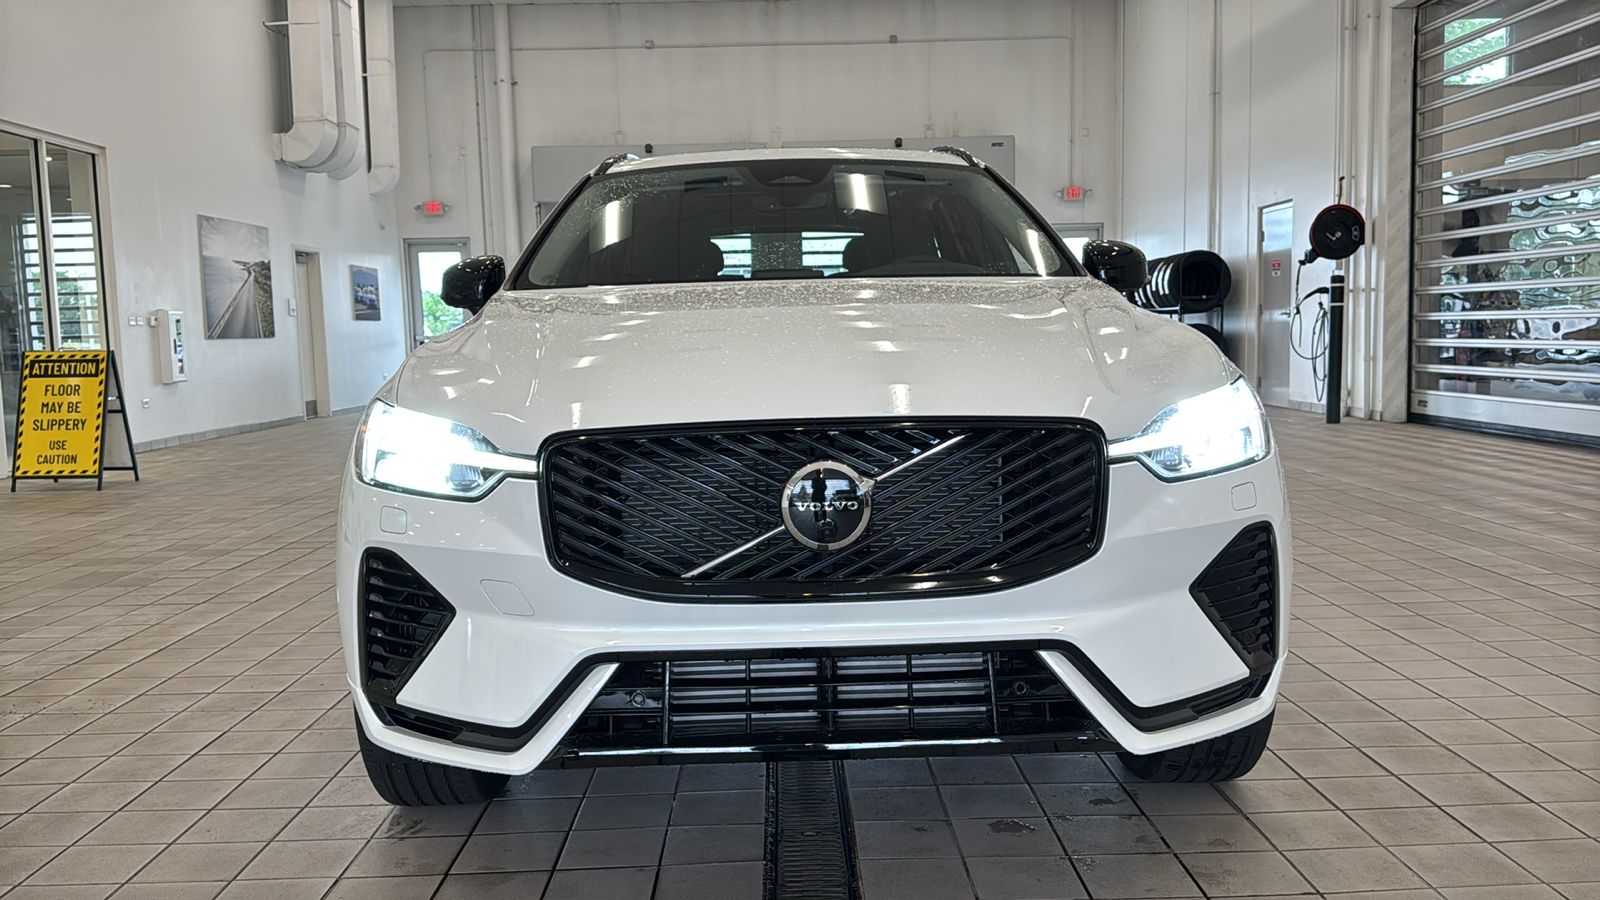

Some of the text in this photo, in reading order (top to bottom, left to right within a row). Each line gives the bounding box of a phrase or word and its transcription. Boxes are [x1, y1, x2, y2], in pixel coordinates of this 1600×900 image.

[1066, 187, 1080, 198] EXIT
[426, 201, 440, 213] EXIT
[32, 362, 96, 375] ATTENTION
[44, 384, 81, 397] FLOOR
[41, 401, 82, 414] MAY BE
[32, 418, 87, 431] SLIPPERY
[49, 440, 67, 450] USE
[36, 454, 77, 464] CAUTION
[793, 501, 859, 511] VOLVO
